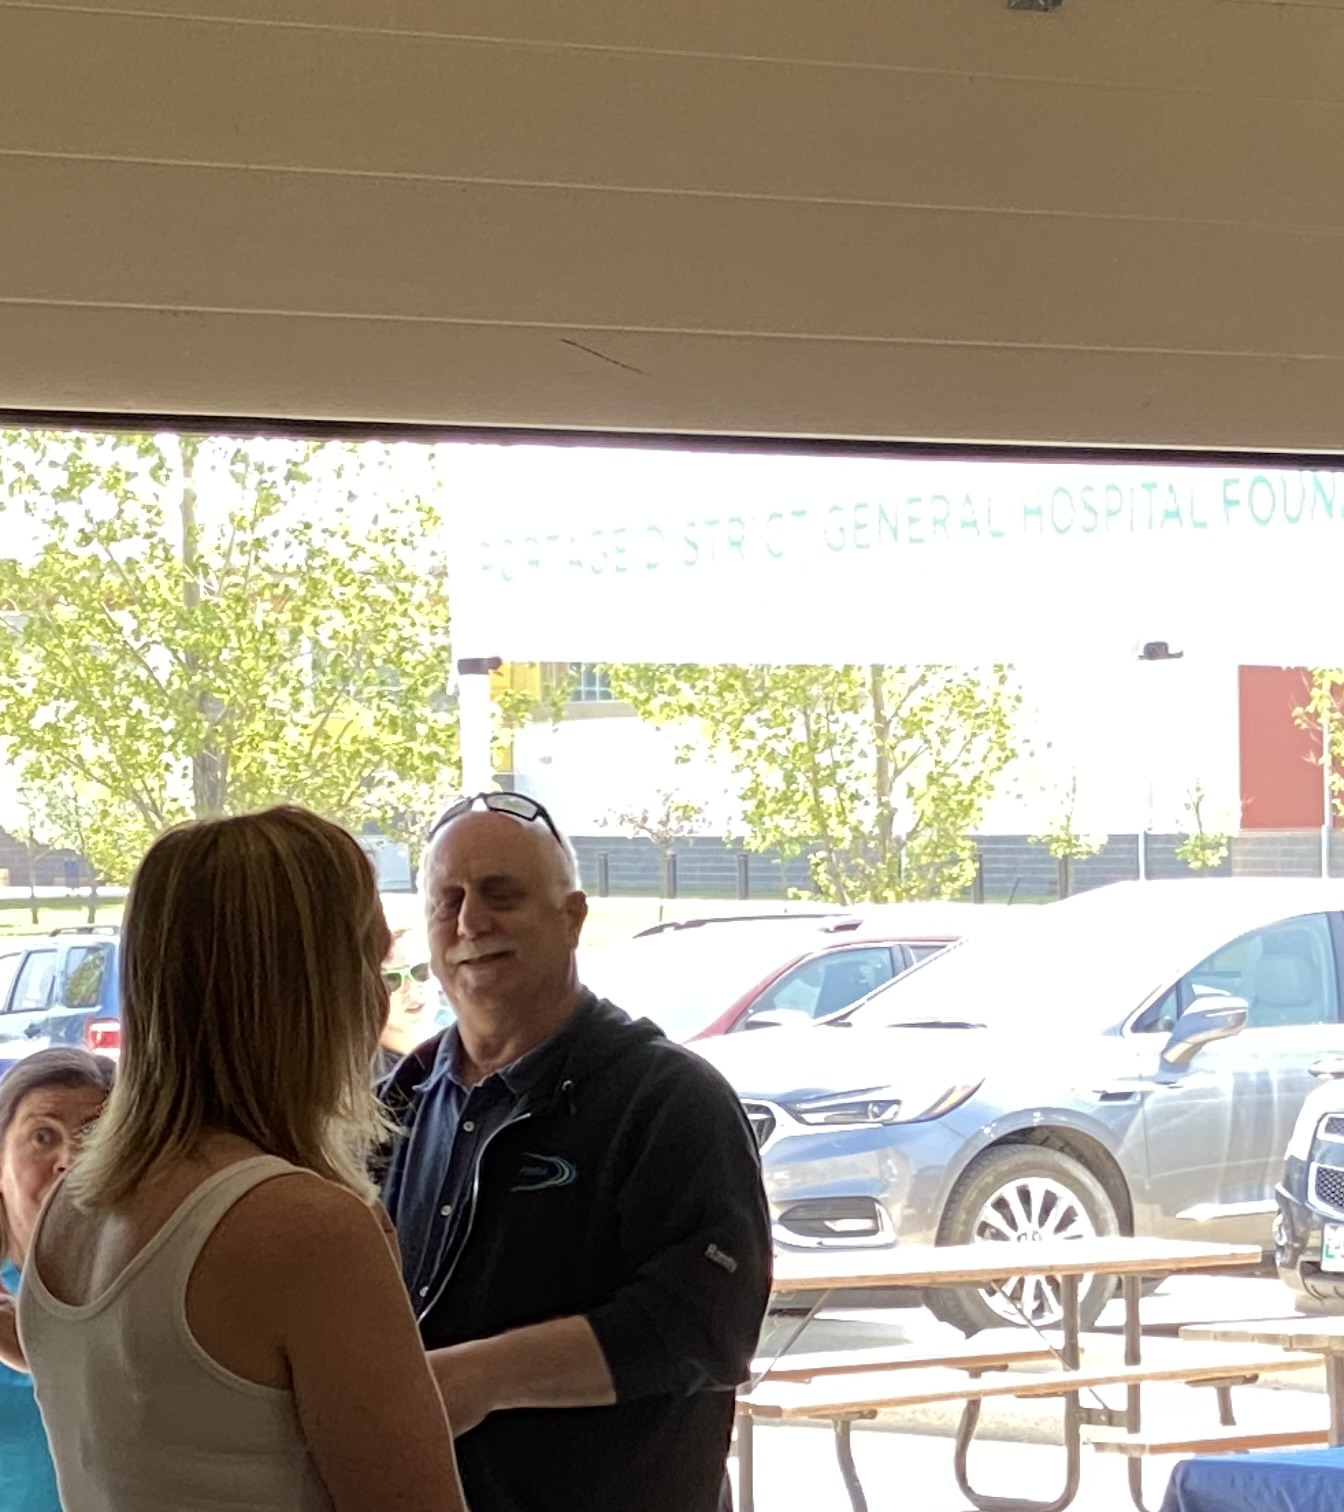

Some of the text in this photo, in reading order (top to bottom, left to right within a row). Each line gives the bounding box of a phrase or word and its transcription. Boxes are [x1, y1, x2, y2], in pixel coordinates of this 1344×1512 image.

[645, 509, 808, 572] DSTRCT
[823, 493, 1006, 552] GENERAL
[1022, 480, 1209, 535] HOSPITAL
